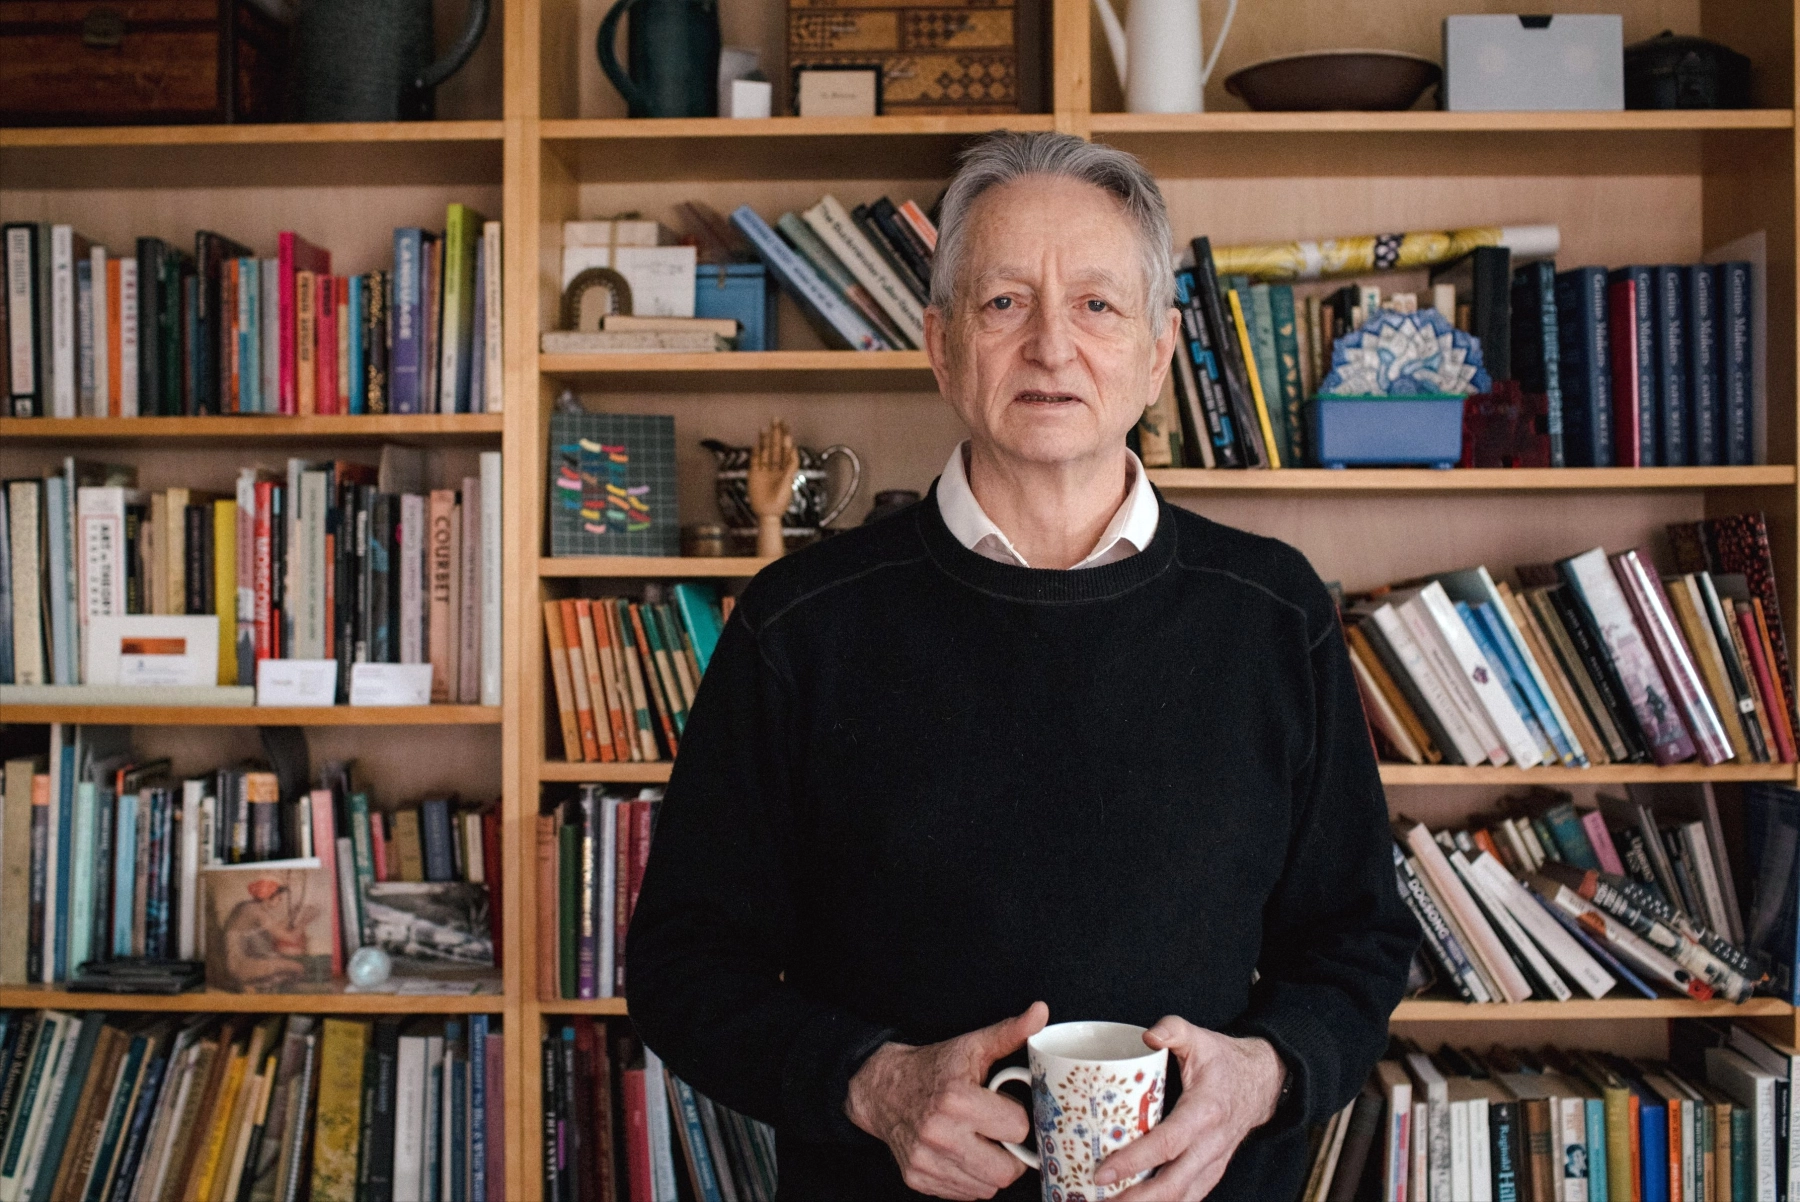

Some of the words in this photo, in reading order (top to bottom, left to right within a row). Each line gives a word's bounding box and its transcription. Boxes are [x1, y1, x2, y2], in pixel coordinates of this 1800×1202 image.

[399, 237, 412, 340] LANGUAGE
[1594, 274, 1606, 320] Genius
[1639, 273, 1651, 318] Genius
[1666, 272, 1678, 316] Genius
[1698, 272, 1710, 316] Genius
[1733, 270, 1746, 314] Genius
[1596, 322, 1608, 368] Makers
[1640, 320, 1652, 366] Makers
[1668, 320, 1680, 366] Makers
[1700, 320, 1712, 365] Makers
[1734, 317, 1746, 363] Makers
[1598, 376, 1607, 408] CADE
[1641, 375, 1650, 406] CADE
[1670, 374, 1680, 406] CADE
[1701, 374, 1711, 406] CADE
[1735, 371, 1744, 403] CADE
[1599, 412, 1608, 445] METZ
[1642, 411, 1650, 445] METZ
[1671, 411, 1680, 444] METZ
[1702, 411, 1711, 444] METZ
[1736, 408, 1744, 442] METZ
[101, 524, 112, 550] ART
[256, 536, 268, 622] MOSCOW
[434, 516, 450, 604] COURBET
[102, 564, 111, 617] THEORY
[1406, 877, 1451, 940] DOGSONG
[1761, 1086, 1773, 1110] THE
[1498, 1124, 1511, 1172] Reginald
[1761, 1112, 1773, 1168] SCIENTIST
[1498, 1172, 1517, 1202] Hill
[1762, 1170, 1773, 1186] AS
